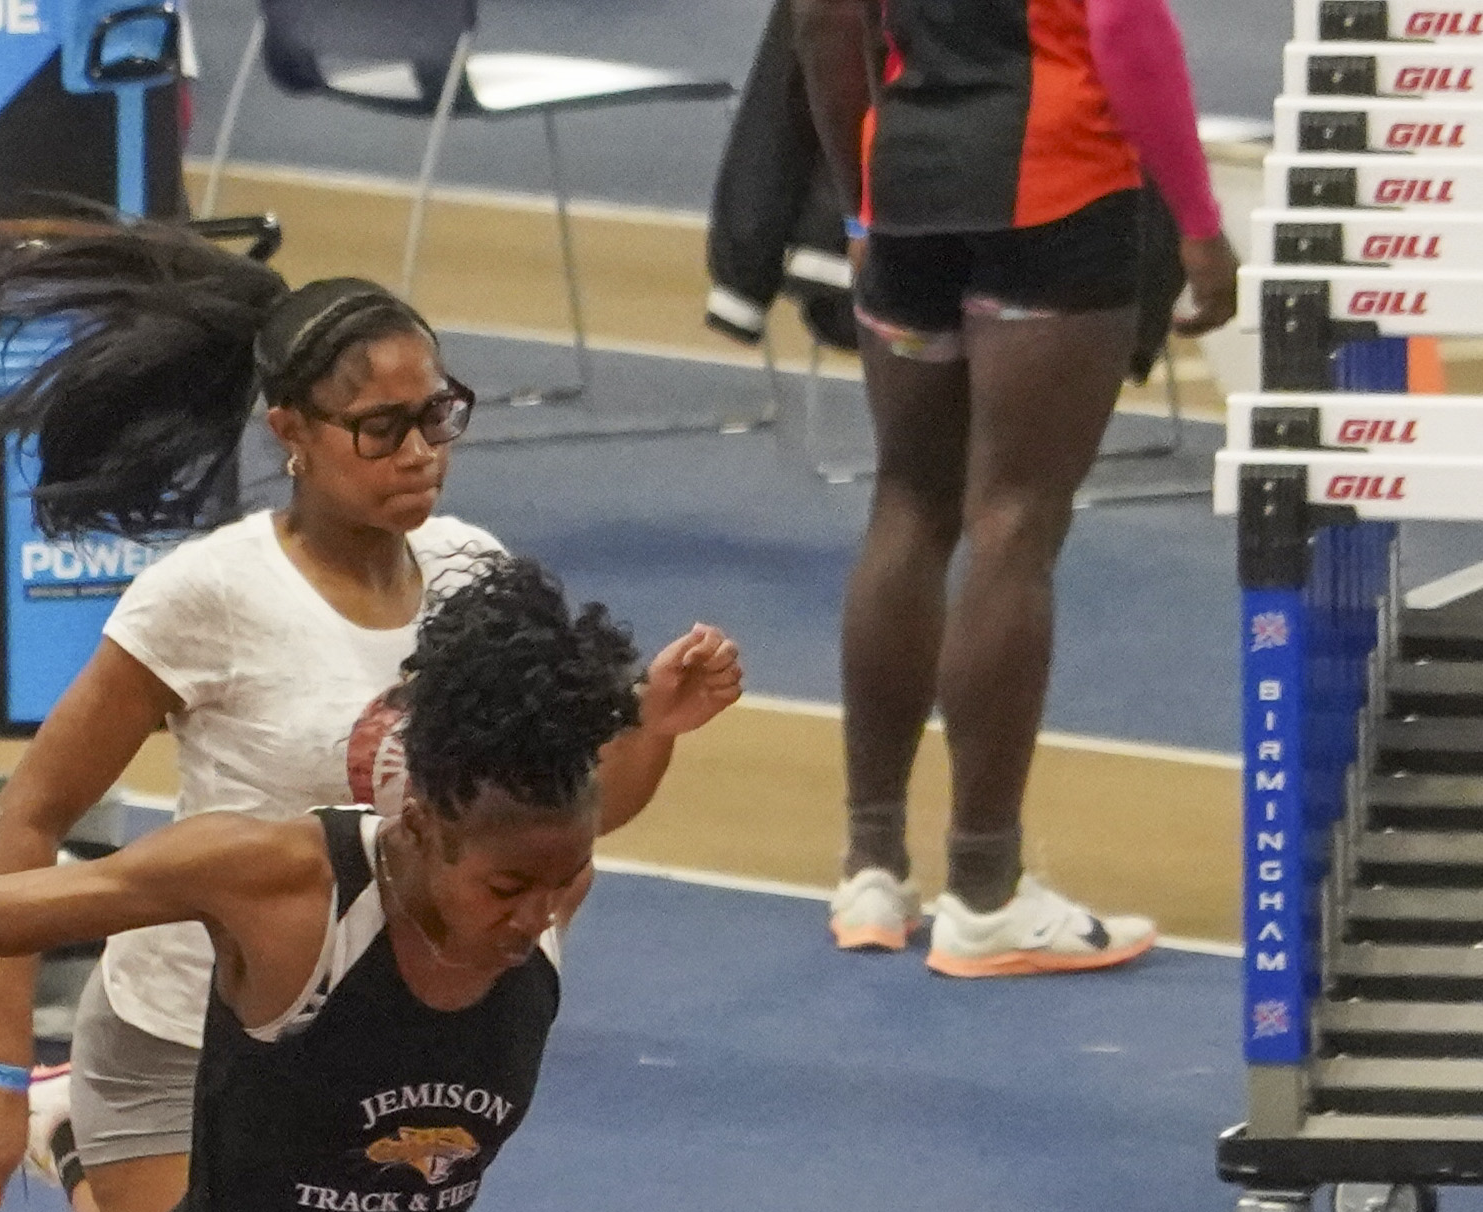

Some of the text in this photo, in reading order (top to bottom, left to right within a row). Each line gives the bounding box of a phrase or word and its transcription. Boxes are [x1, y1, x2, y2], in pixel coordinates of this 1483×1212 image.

[1404, 12, 1483, 36] GILL
[1393, 68, 1474, 92] GILL
[1385, 123, 1465, 148] GILL
[1374, 179, 1454, 204] GILL
[1362, 235, 1441, 259] GILL
[1347, 291, 1428, 315] GILL
[1337, 419, 1418, 444] GILL
[1325, 475, 1405, 500] GILL
[1256, 680, 1286, 971] BIRMINGHAM
[360, 1082, 514, 1129] JEMISON
[296, 1183, 402, 1212] TRACK
[408, 1193, 430, 1212] &
